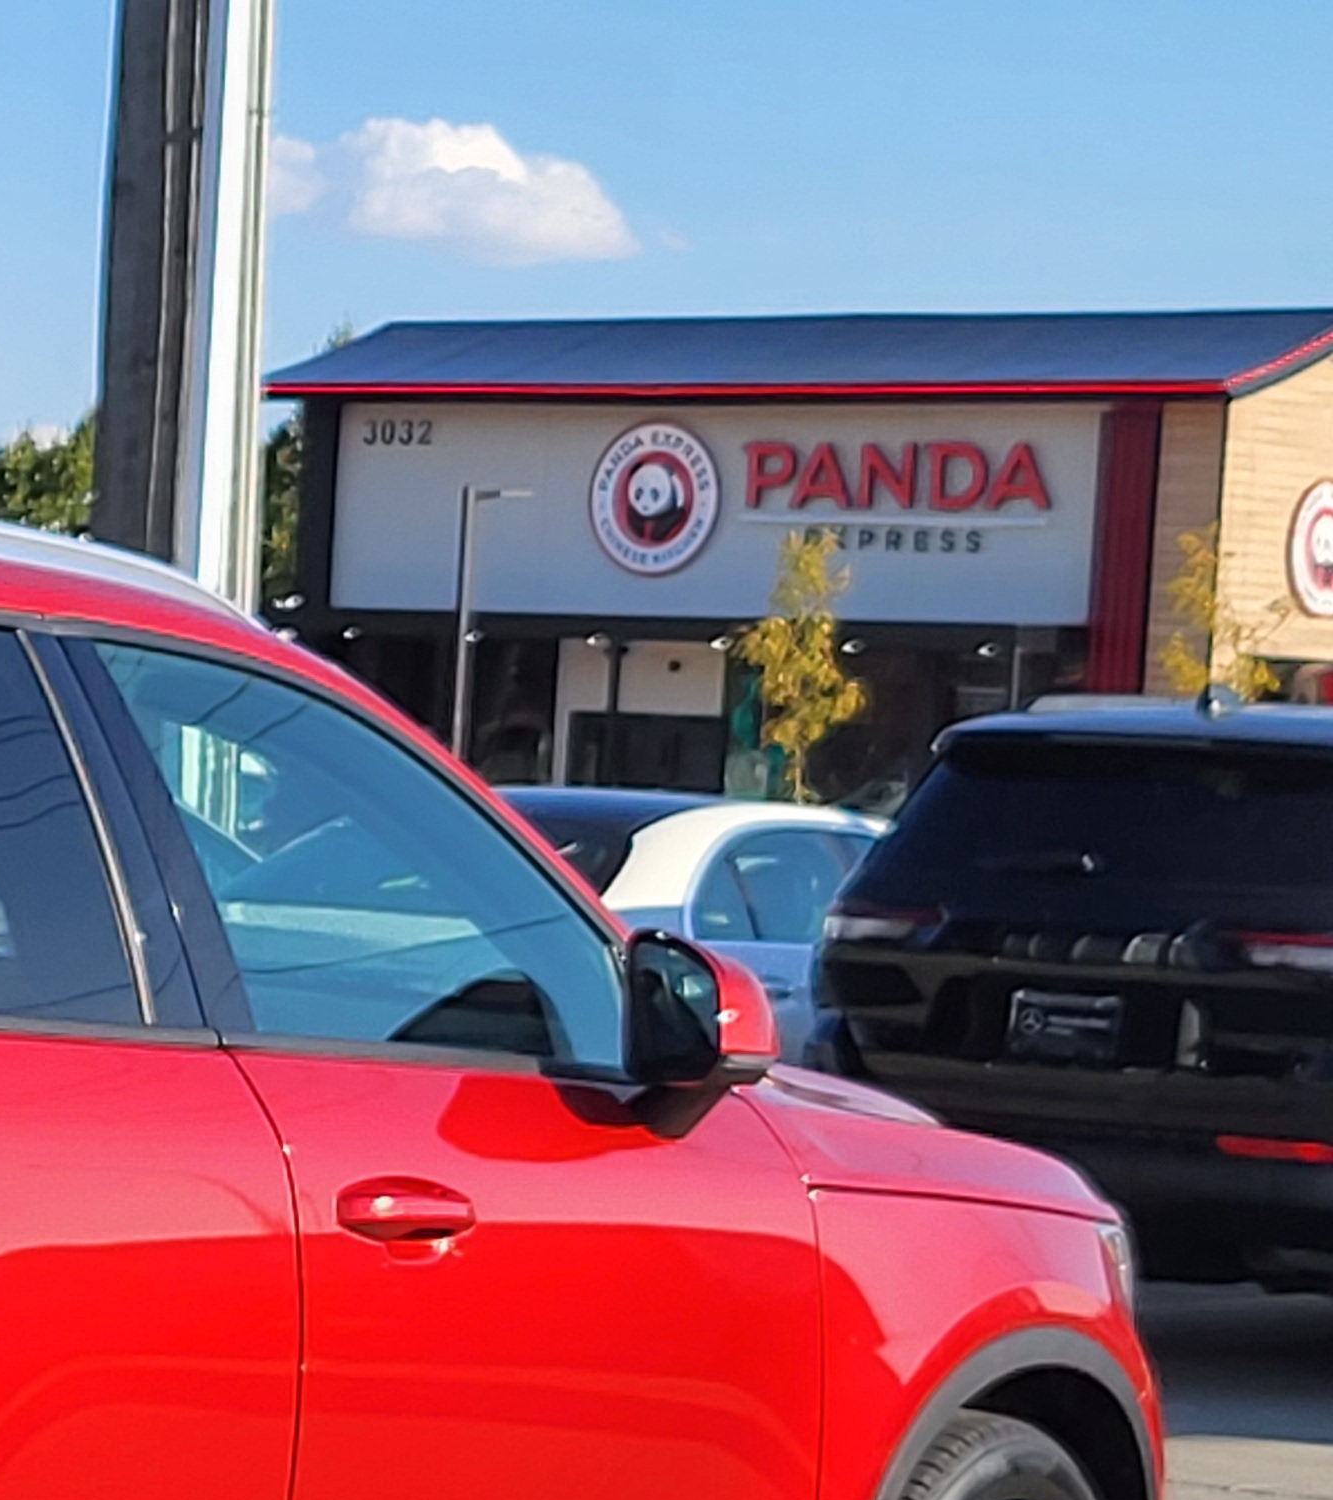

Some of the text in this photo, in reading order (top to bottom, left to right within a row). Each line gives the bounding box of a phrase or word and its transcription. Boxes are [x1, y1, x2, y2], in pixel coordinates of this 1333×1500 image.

[363, 418, 432, 447] 3032
[598, 430, 710, 492] PANDA EXPRESS
[742, 440, 1052, 512] PANDA
